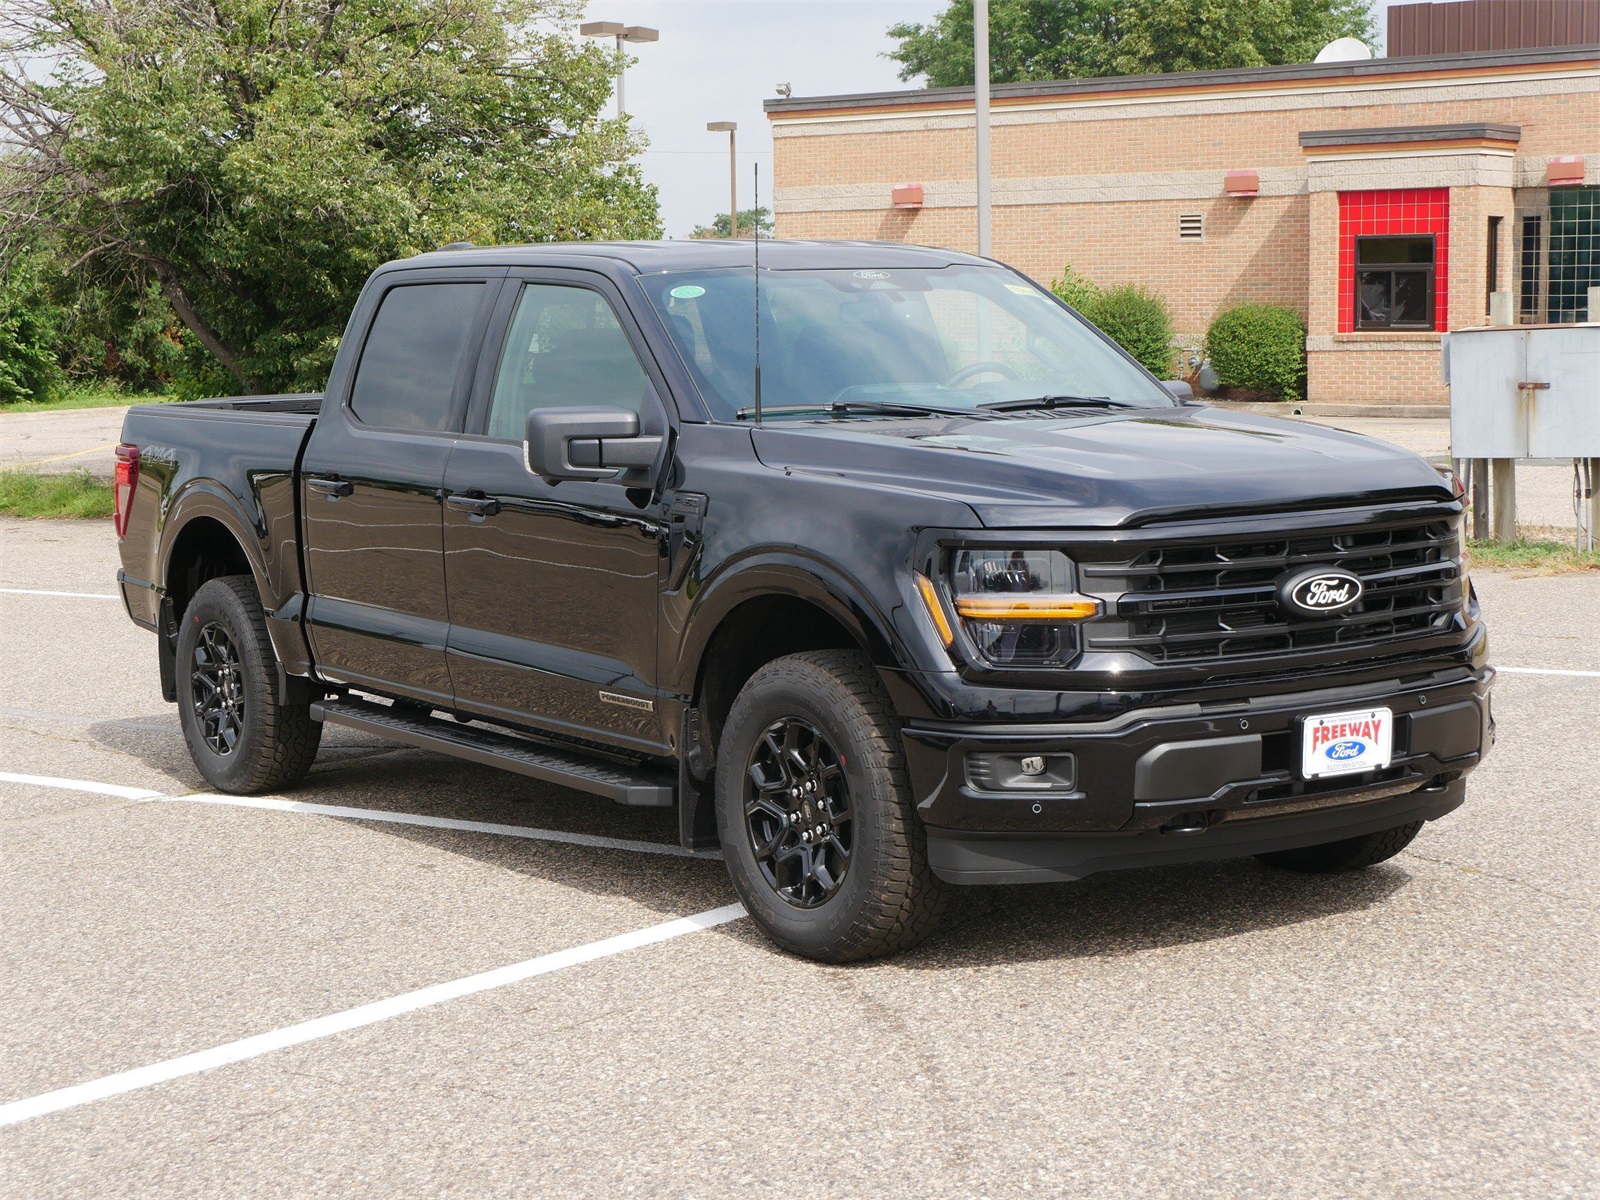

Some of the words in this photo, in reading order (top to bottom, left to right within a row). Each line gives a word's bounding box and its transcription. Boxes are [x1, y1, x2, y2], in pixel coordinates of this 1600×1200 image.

[1306, 579, 1350, 605] Ford
[601, 693, 650, 709] POWERBOOST
[1312, 719, 1382, 755] FREEWAY
[1332, 742, 1360, 759] Ford
[1326, 760, 1367, 771] BLOOMINGTON
